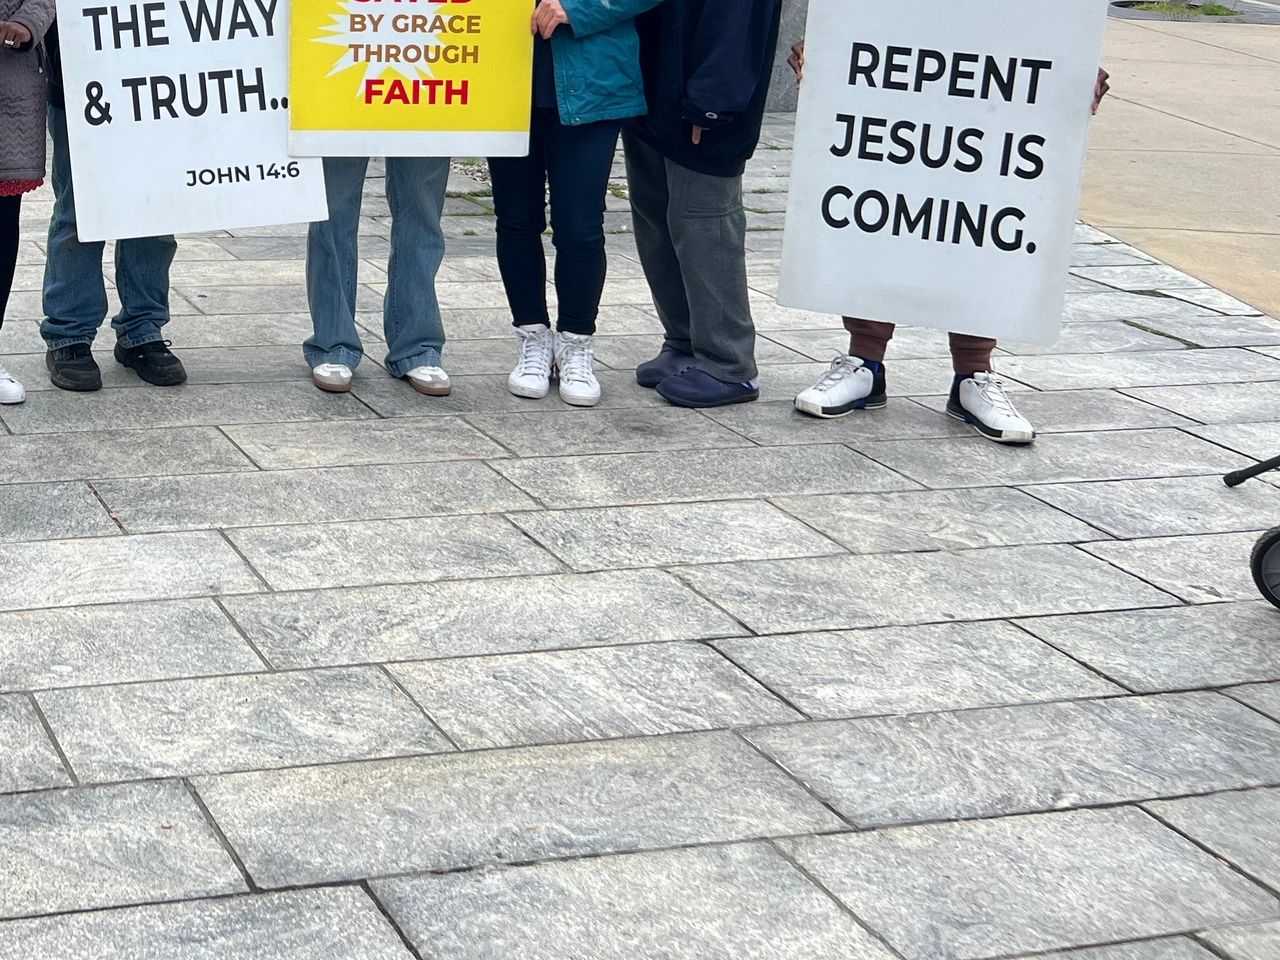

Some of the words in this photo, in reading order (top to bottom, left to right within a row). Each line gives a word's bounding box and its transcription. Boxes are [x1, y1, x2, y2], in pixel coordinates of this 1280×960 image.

[82, 2, 170, 51] THE
[349, 13, 385, 33] BY
[391, 14, 481, 34] GRACE
[348, 44, 479, 64] THROUGH
[847, 42, 1053, 105] REPENT
[84, 80, 113, 126] &
[364, 79, 469, 105] FAITH
[829, 113, 985, 173] JESUS
[999, 132, 1046, 180] IS
[186, 165, 251, 187] JOHN
[256, 161, 300, 180] 14:6
[821, 185, 1037, 255] COMING.
